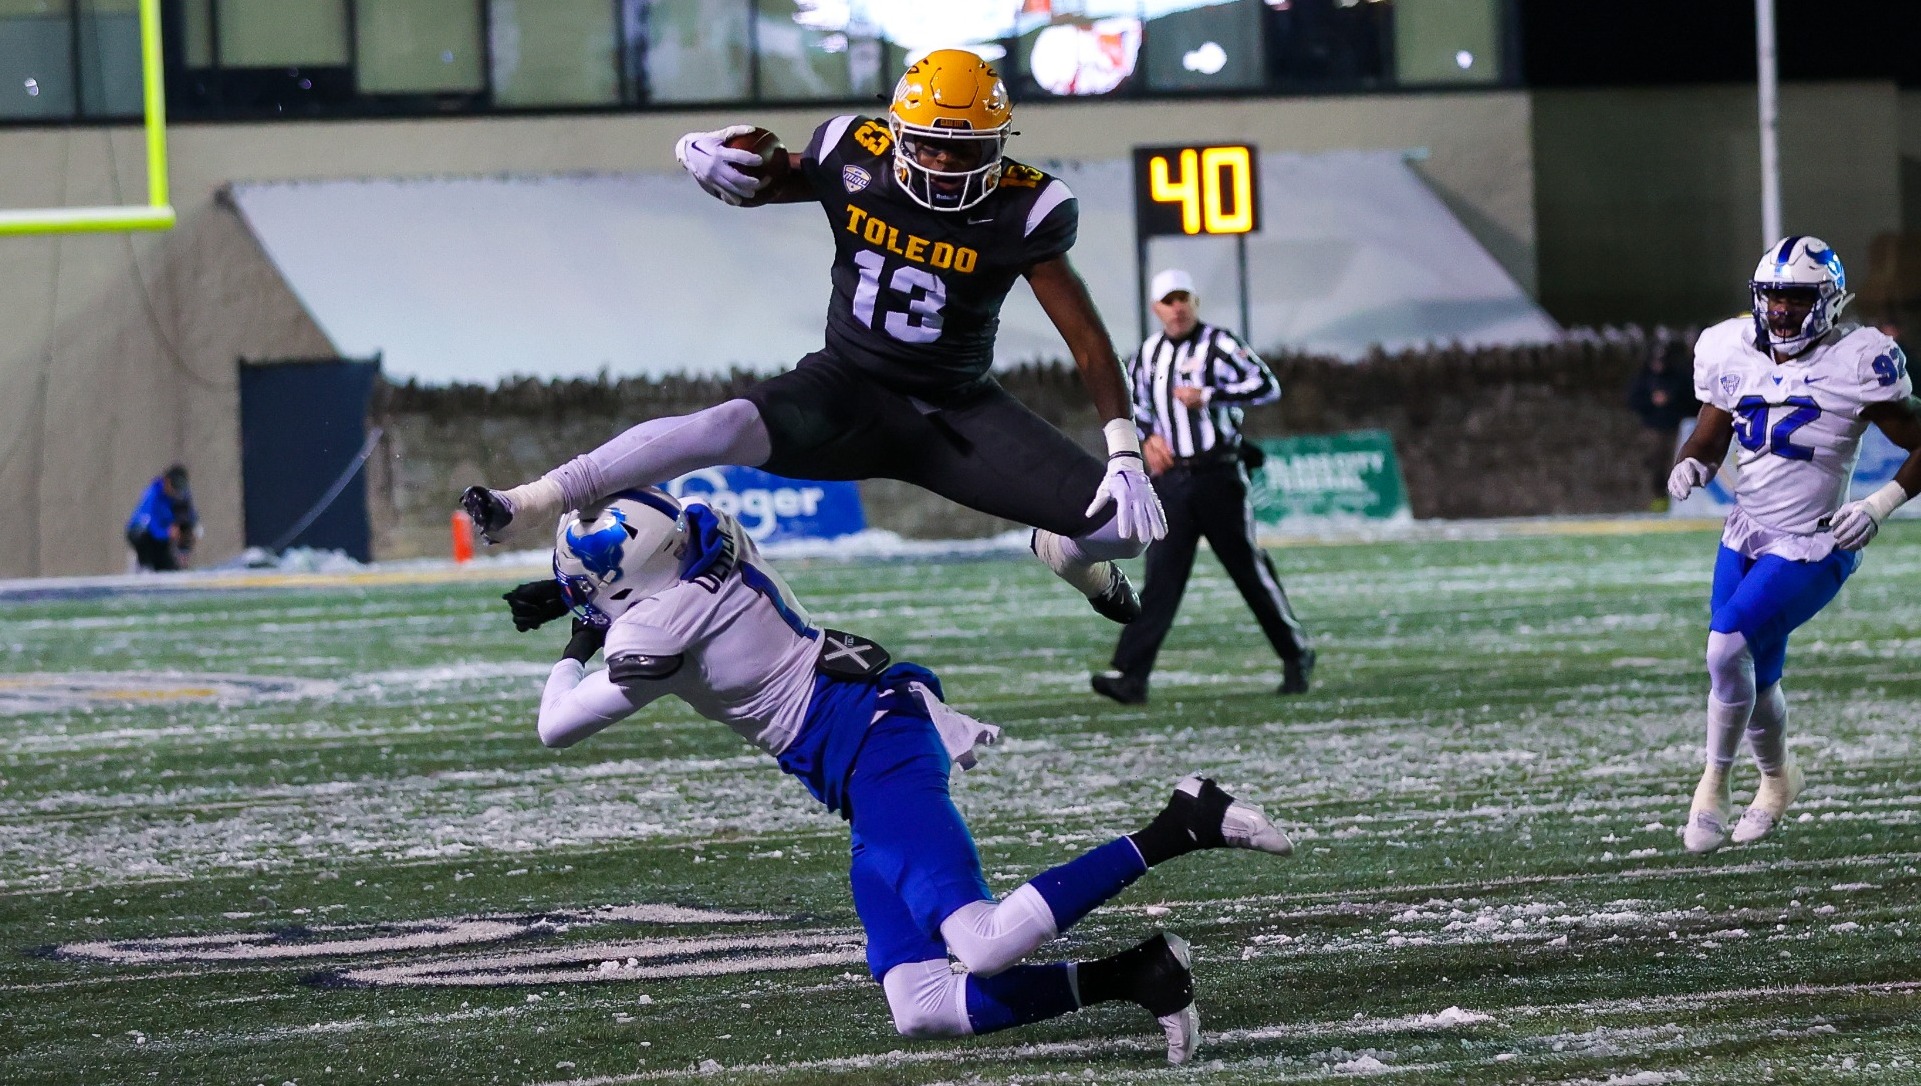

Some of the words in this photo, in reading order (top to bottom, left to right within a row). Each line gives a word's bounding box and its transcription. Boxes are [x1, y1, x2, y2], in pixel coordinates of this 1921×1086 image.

[1150, 146, 1254, 235] 40
[846, 203, 978, 274] TOLEDO
[852, 250, 947, 343] 13
[1734, 395, 1822, 461] 92
[668, 465, 825, 540] oger
